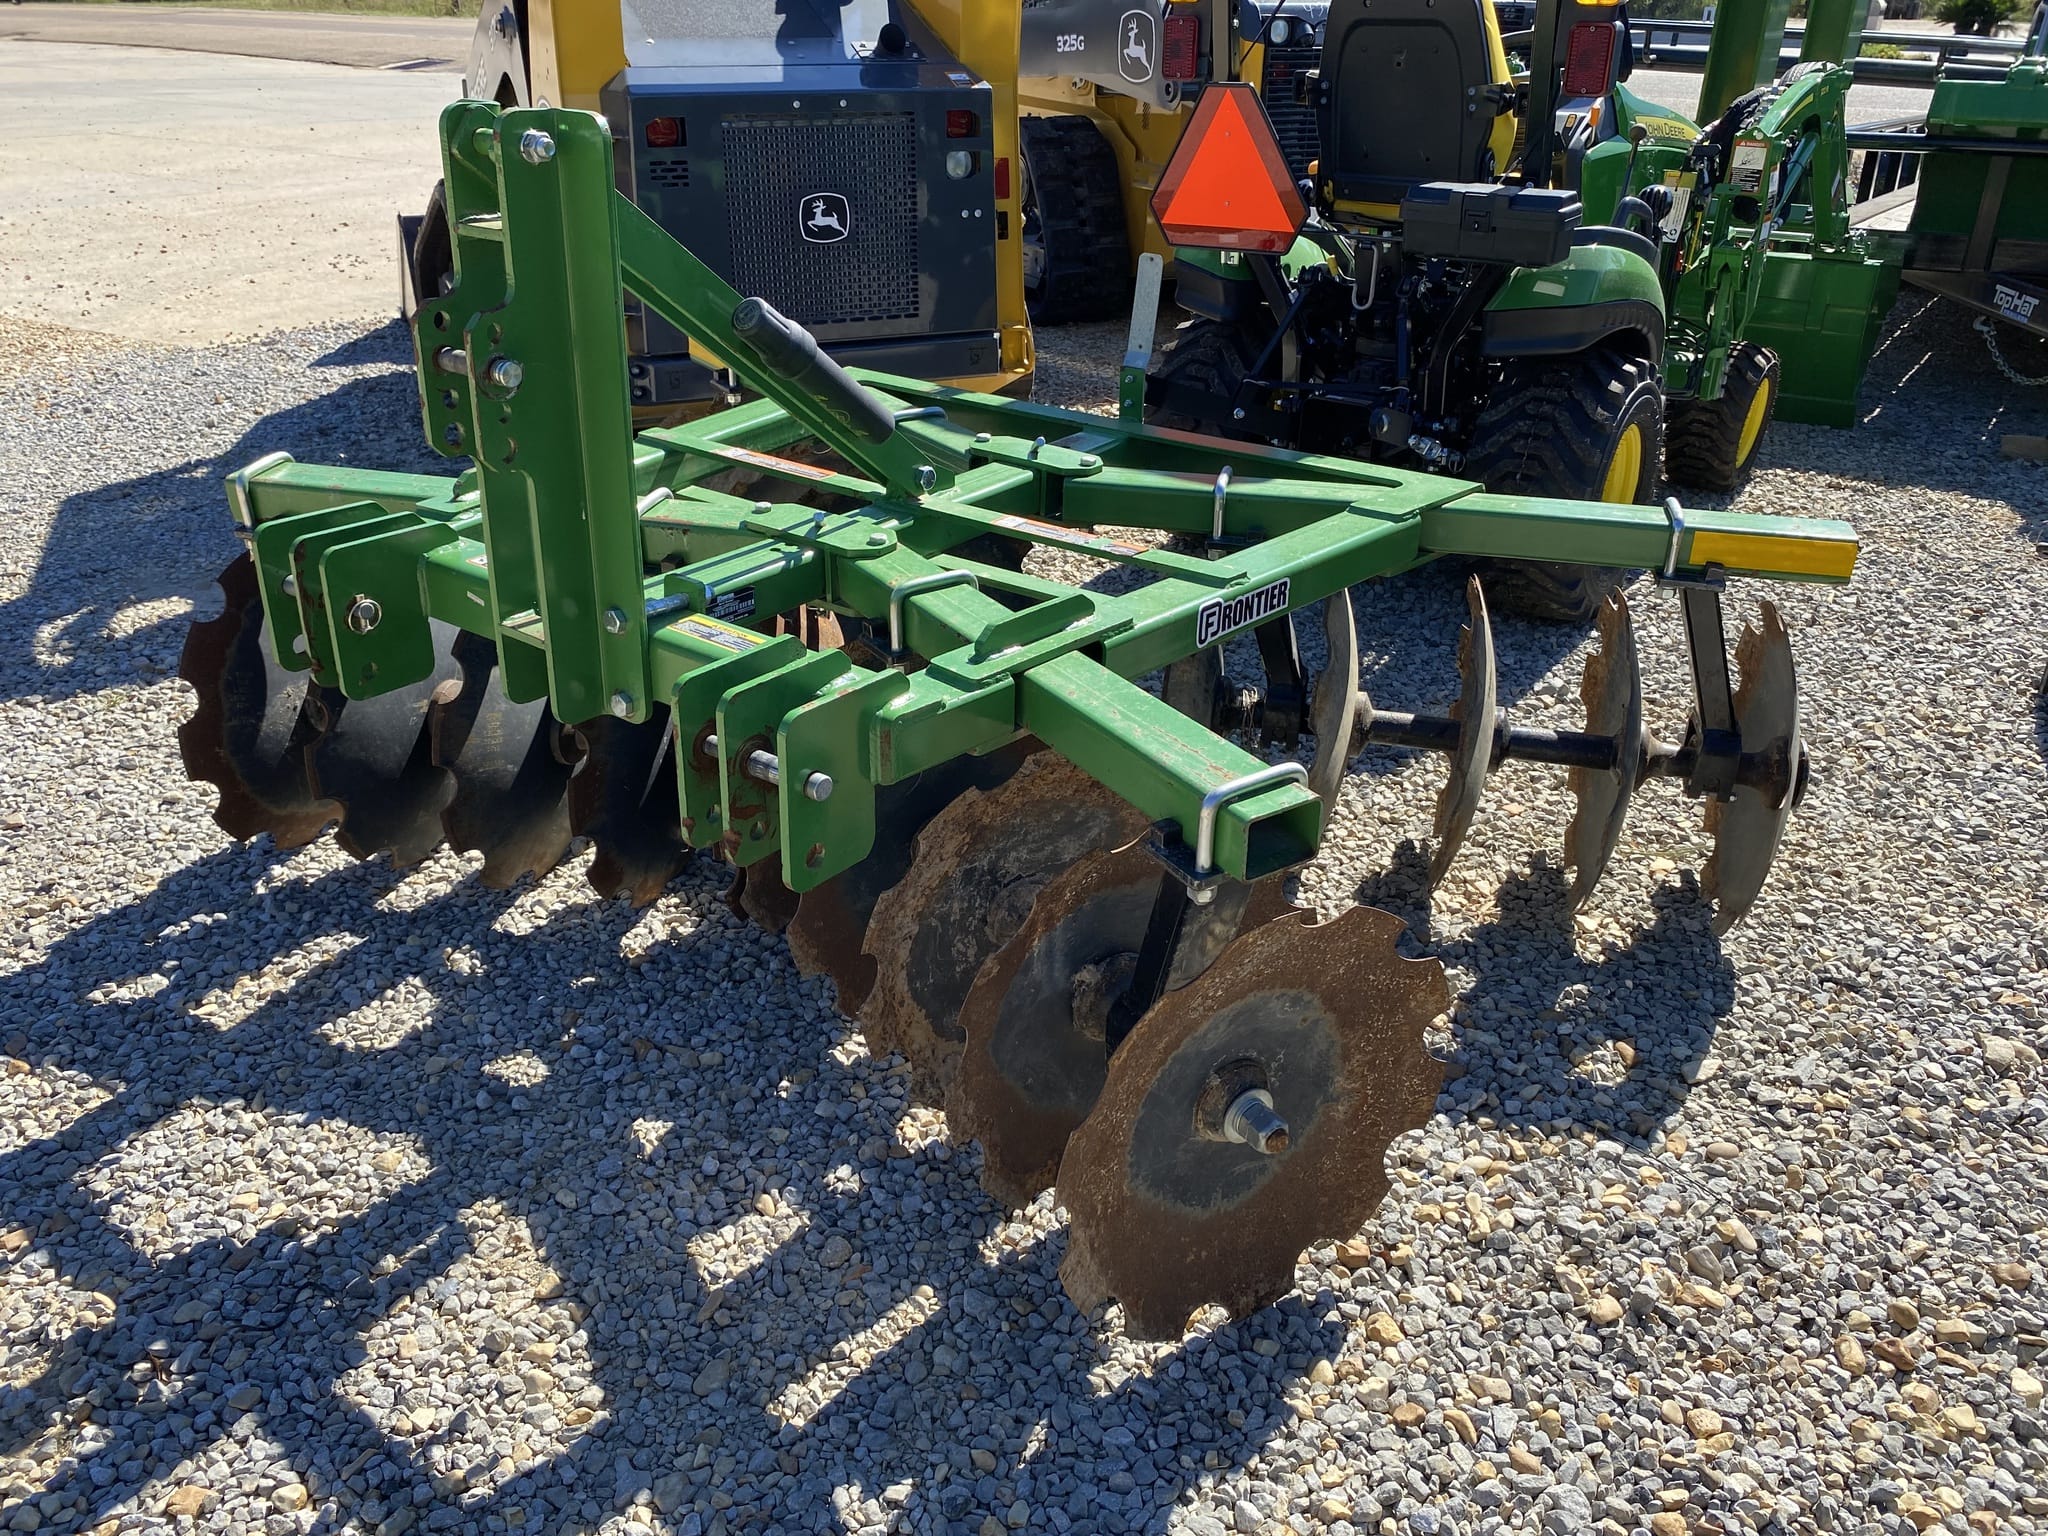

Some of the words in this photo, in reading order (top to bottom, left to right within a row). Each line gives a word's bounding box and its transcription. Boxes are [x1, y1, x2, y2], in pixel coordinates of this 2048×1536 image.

[1056, 35, 1085, 52] 325G
[1664, 122, 1686, 138] DEERE
[1198, 580, 1289, 645] FRONTIER
